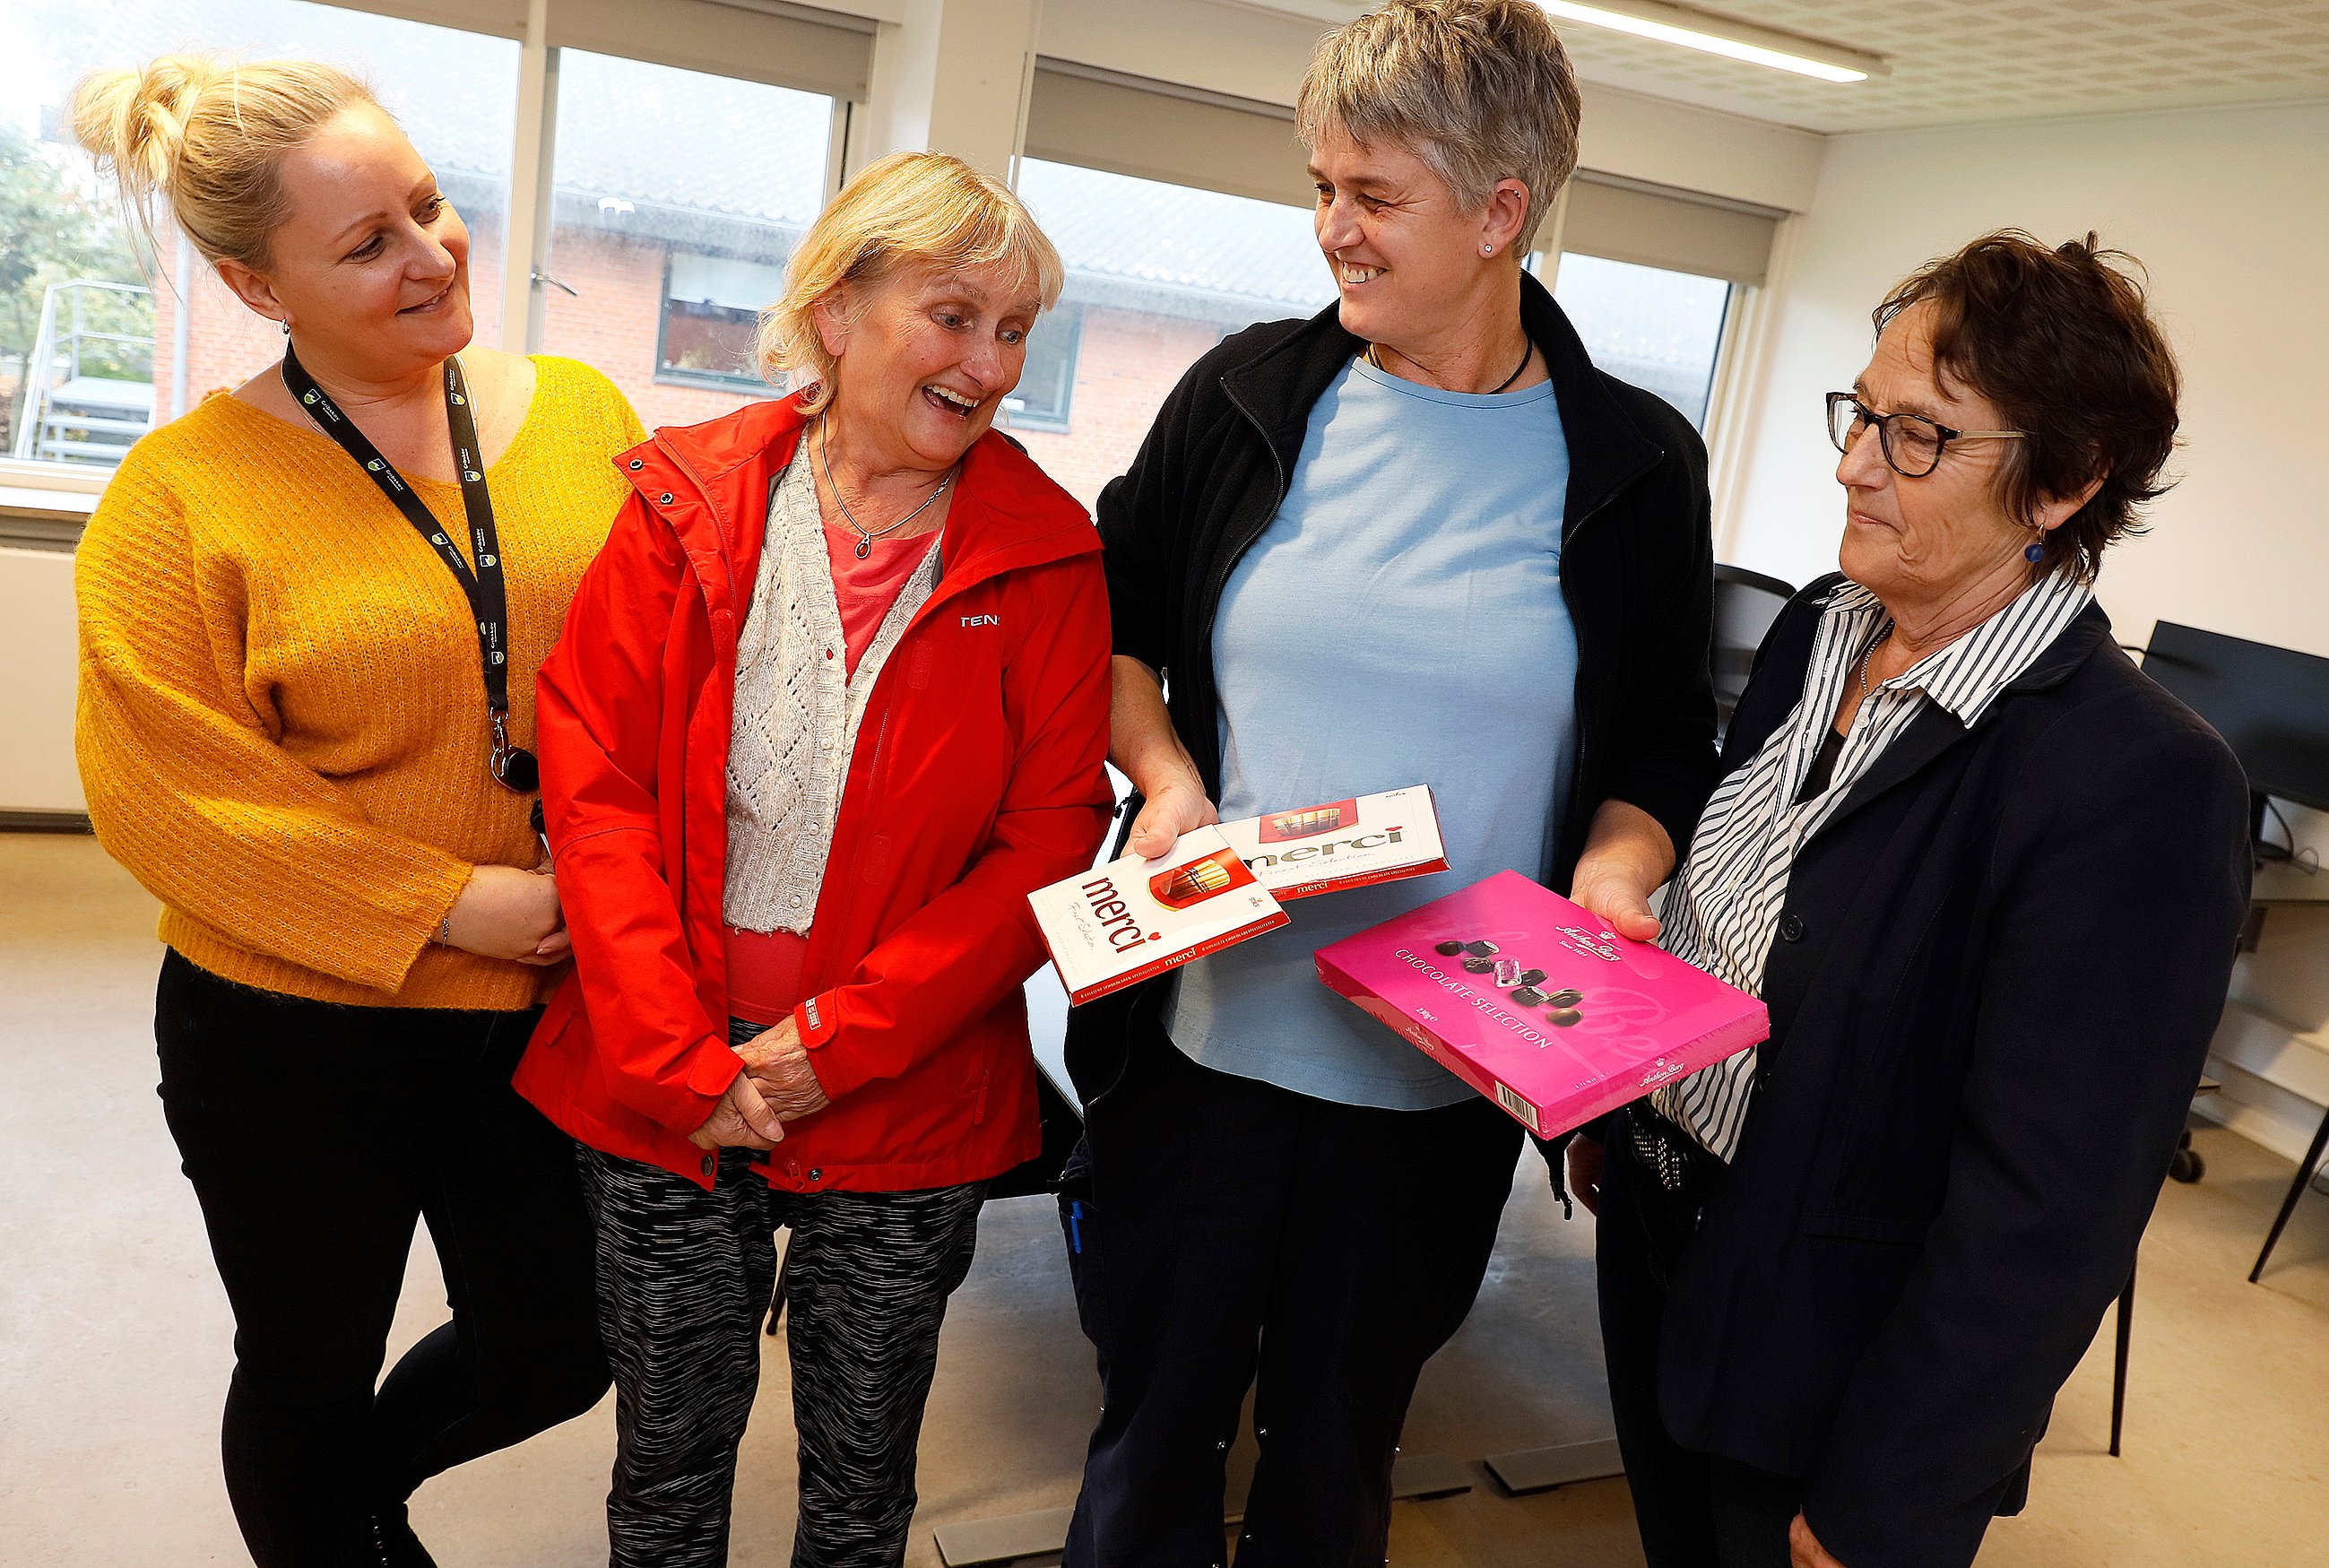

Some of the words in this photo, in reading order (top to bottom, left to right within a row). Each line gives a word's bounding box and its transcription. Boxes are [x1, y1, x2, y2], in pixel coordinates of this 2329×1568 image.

[960, 614, 1000, 628] TEN
[1297, 880, 1329, 894] merci
[1082, 877, 1162, 954] merci
[1554, 926, 1597, 950] Anthon
[1164, 947, 1197, 966] merci
[1395, 949, 1475, 1000] CHOCOLATE
[1470, 998, 1553, 1050] SELECTION
[1639, 1071, 1668, 1087] Anthon
